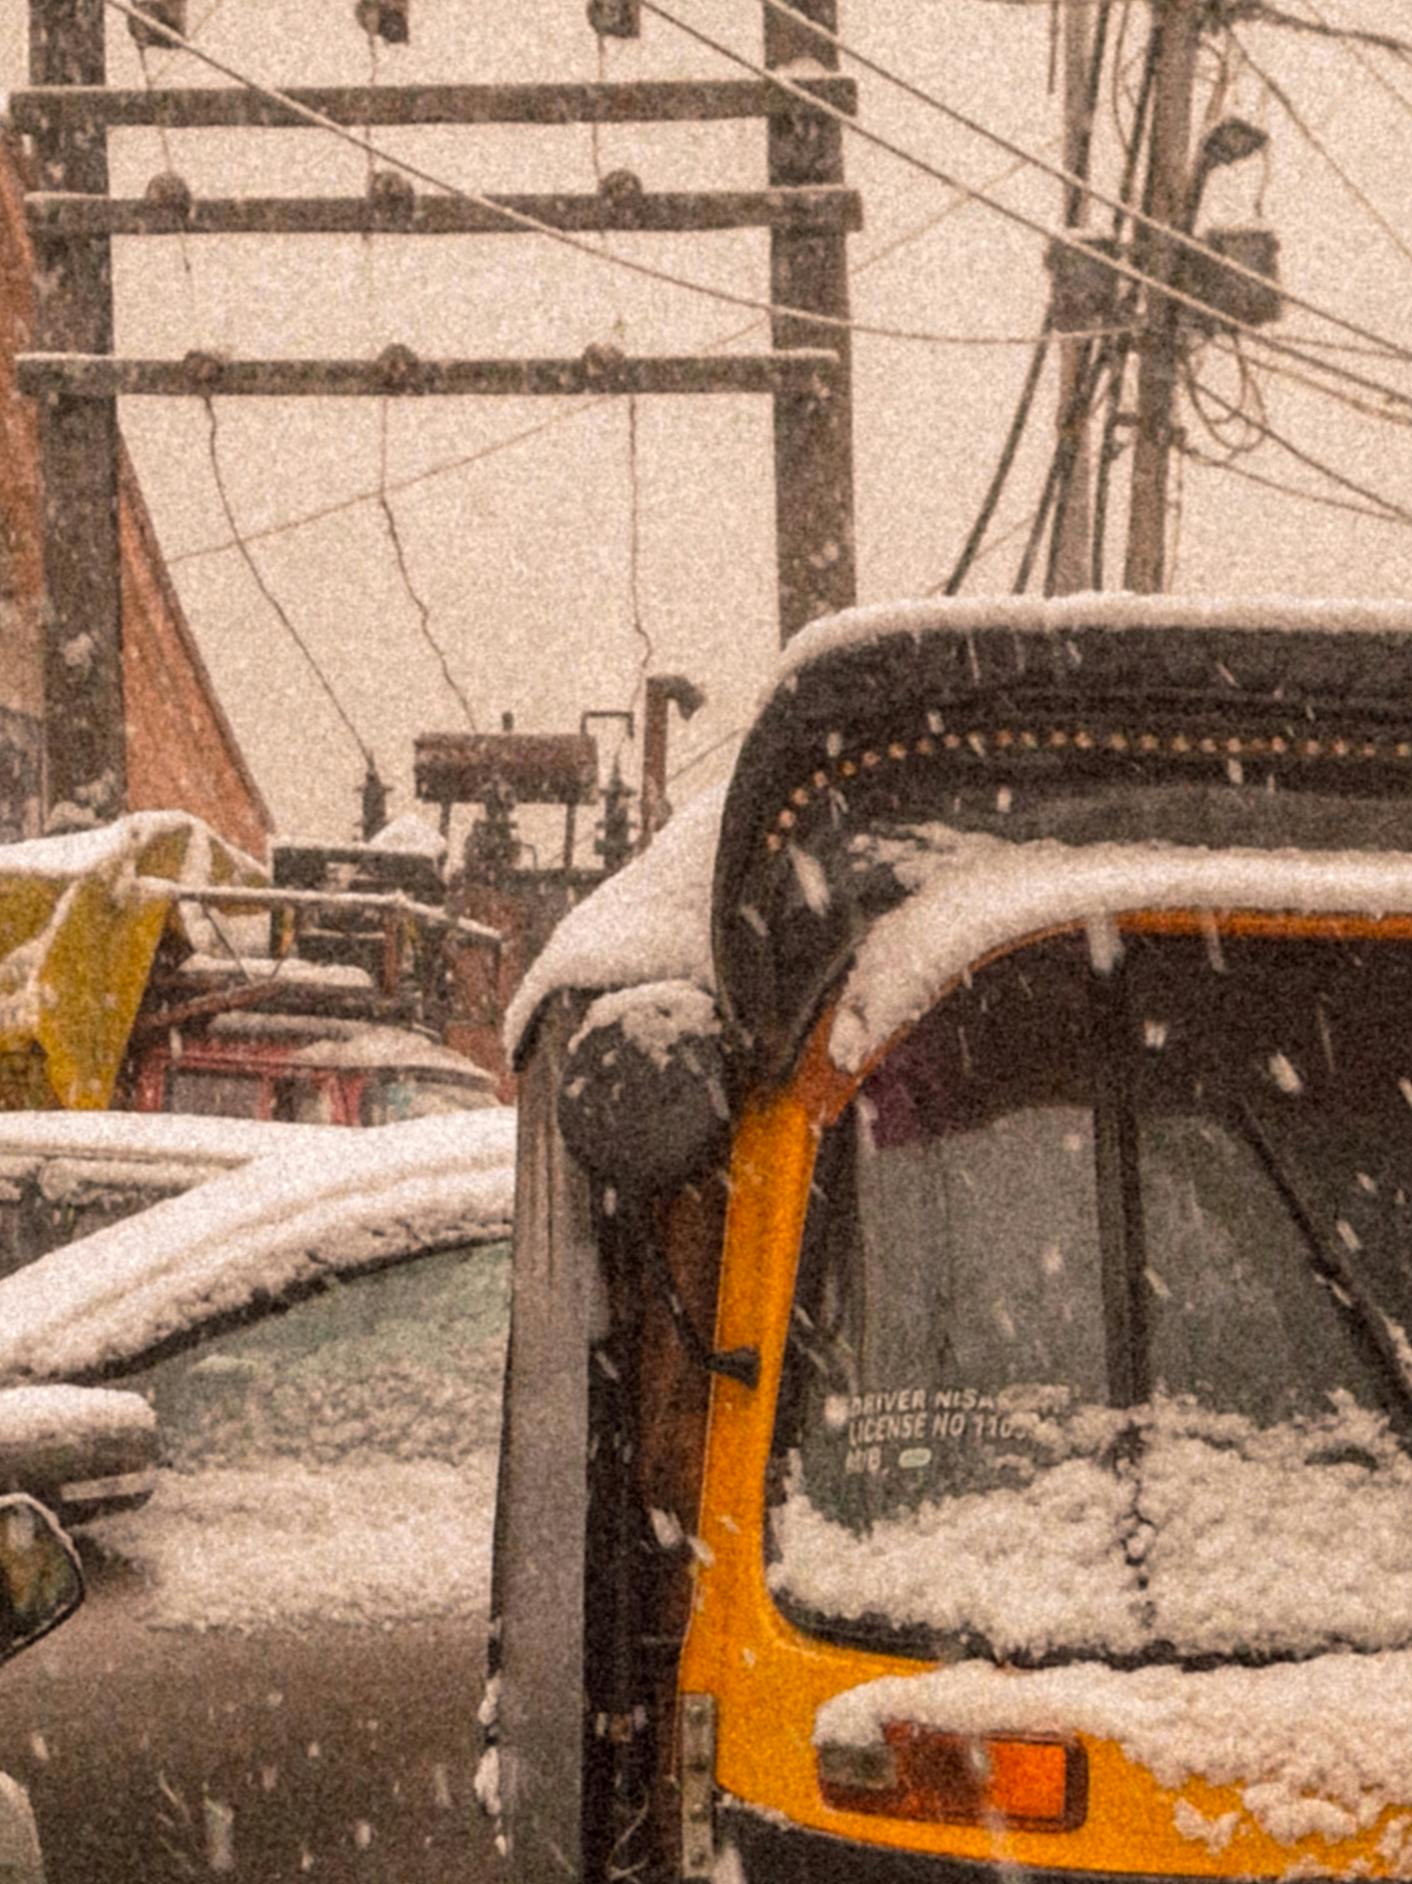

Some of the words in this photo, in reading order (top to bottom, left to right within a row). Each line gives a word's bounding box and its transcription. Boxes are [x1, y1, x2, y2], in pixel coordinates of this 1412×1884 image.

[849, 1388, 926, 1418] DRIVER
[848, 1411, 927, 1446] LICENSE
[932, 1412, 965, 1439] NO
